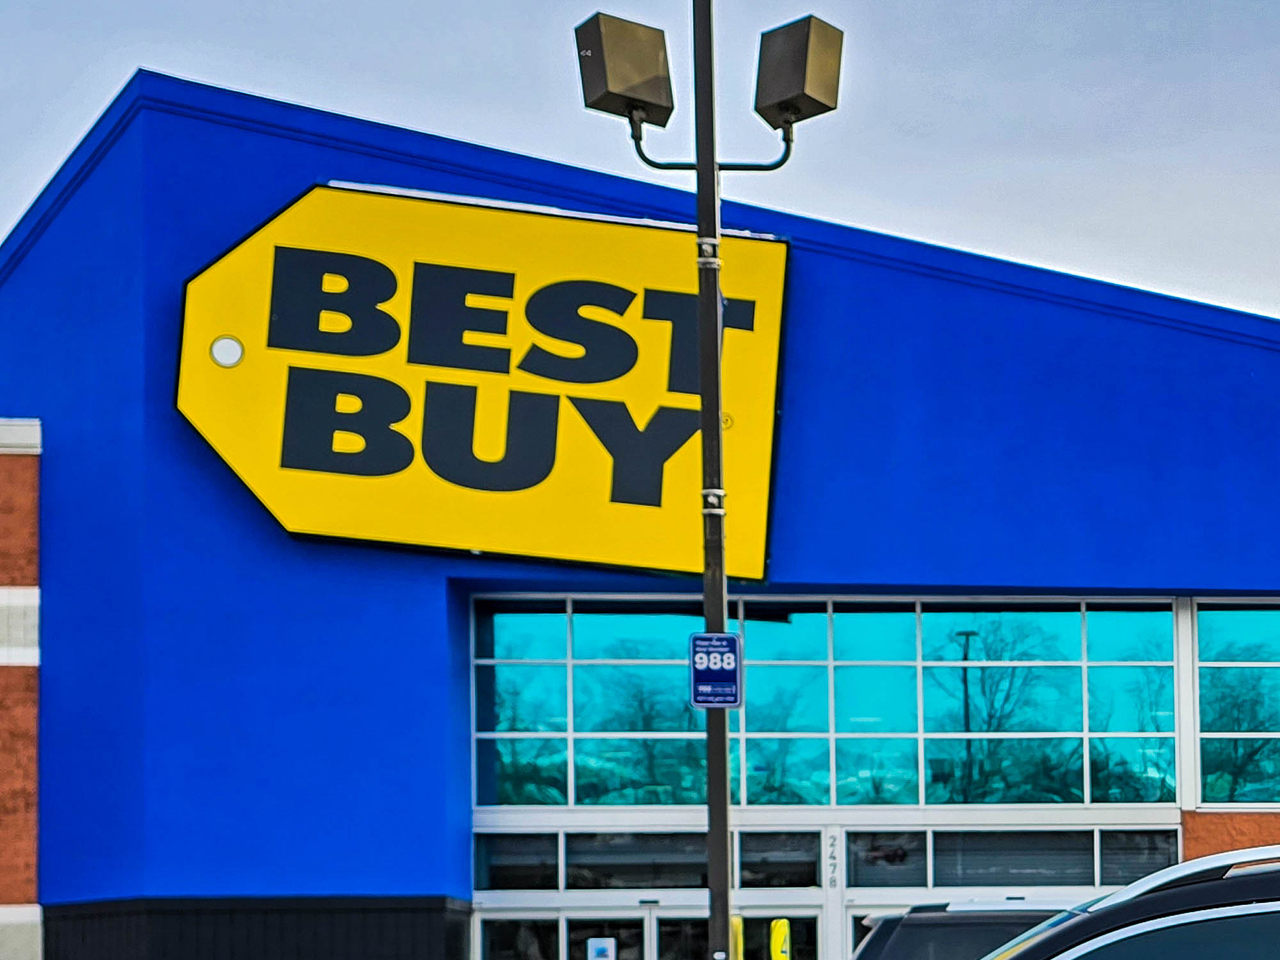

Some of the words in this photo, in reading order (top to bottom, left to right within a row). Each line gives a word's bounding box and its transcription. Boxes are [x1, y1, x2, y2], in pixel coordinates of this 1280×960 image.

[267, 245, 756, 395] BEST
[279, 365, 702, 508] BUY
[694, 652, 736, 670] 988
[828, 834, 838, 889] 2478
